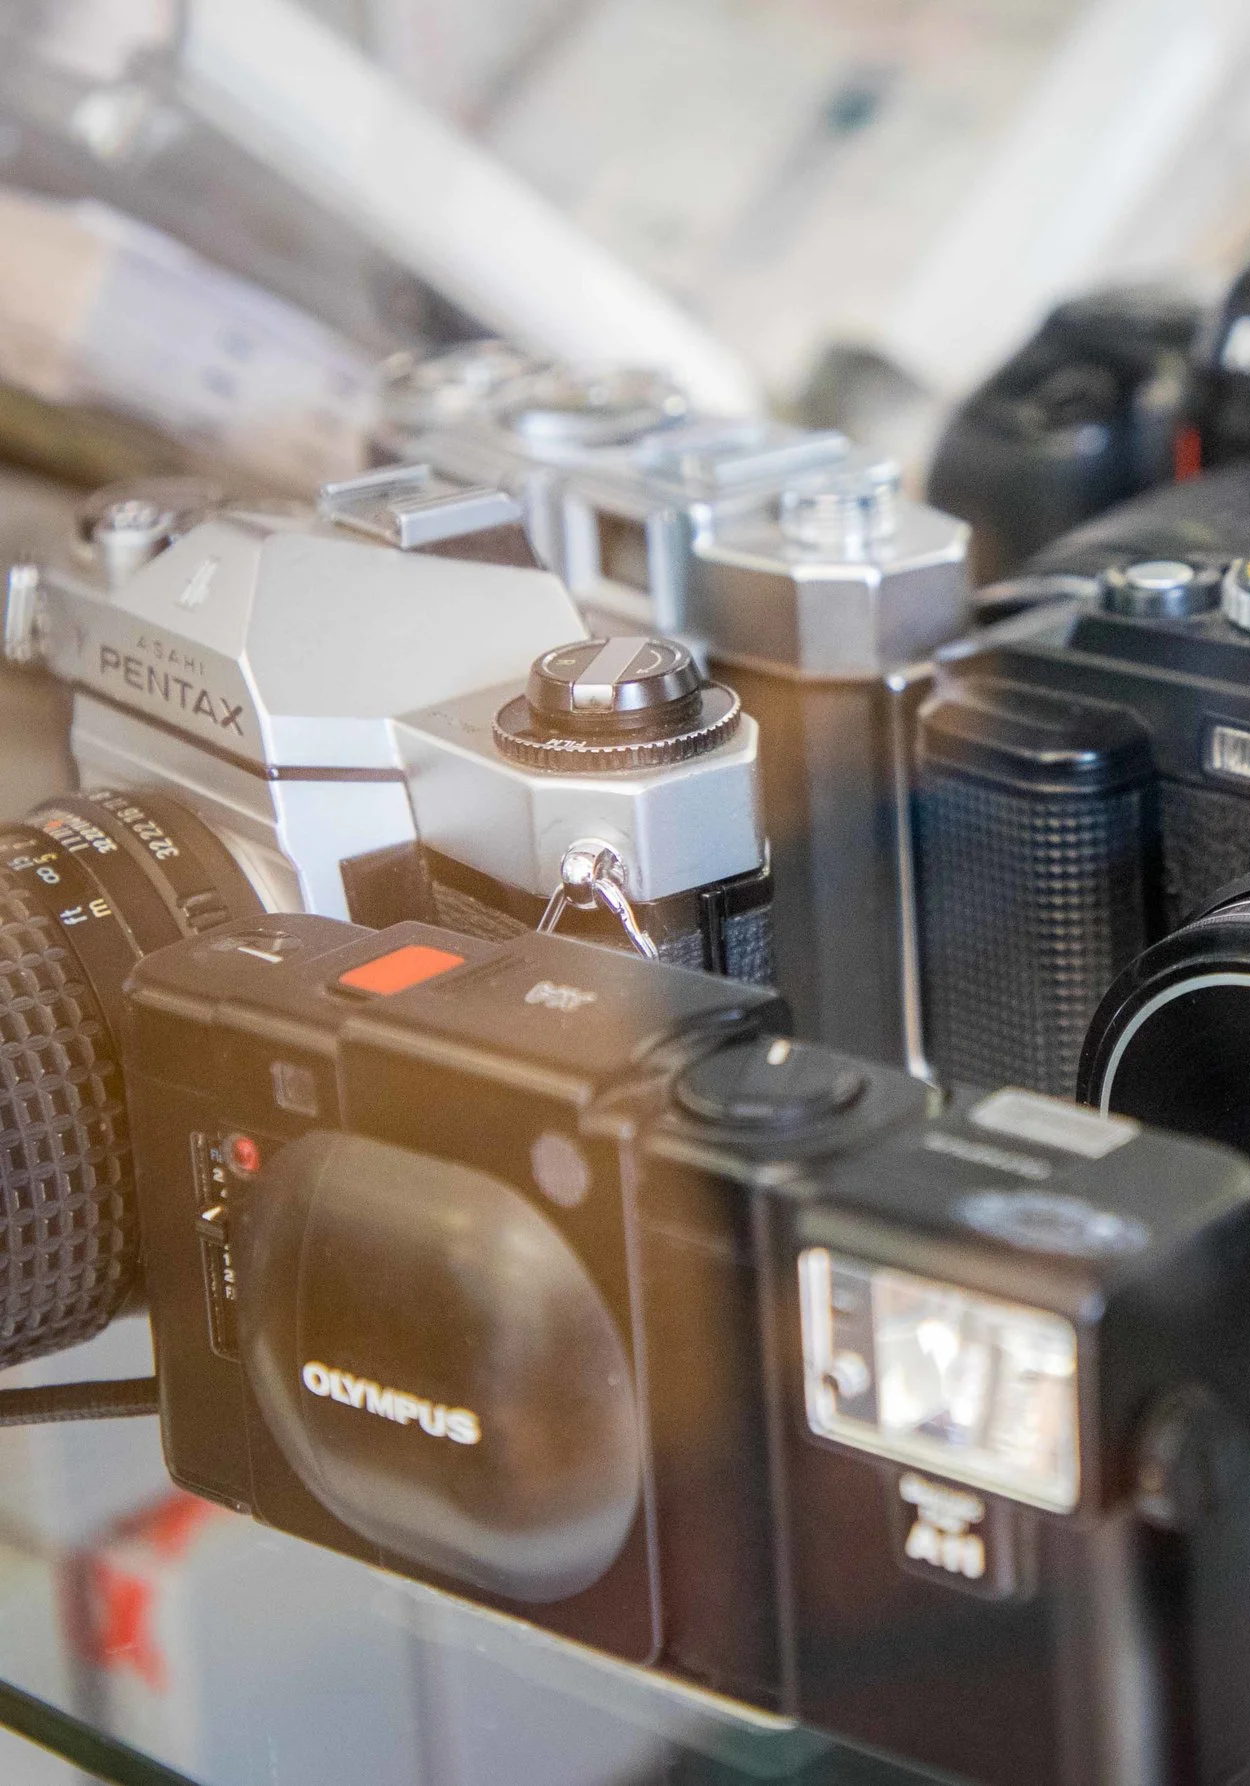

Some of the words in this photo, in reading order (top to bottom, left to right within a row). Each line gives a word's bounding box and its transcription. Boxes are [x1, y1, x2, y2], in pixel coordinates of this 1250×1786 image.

[136, 635, 206, 676] ASAHI
[100, 644, 244, 737] PENTAX
[134, 820, 163, 840] 22
[149, 837, 180, 860] 32
[60, 905, 88, 925] ft
[89, 898, 112, 918] m
[302, 1360, 482, 1445] OLYMPUS
